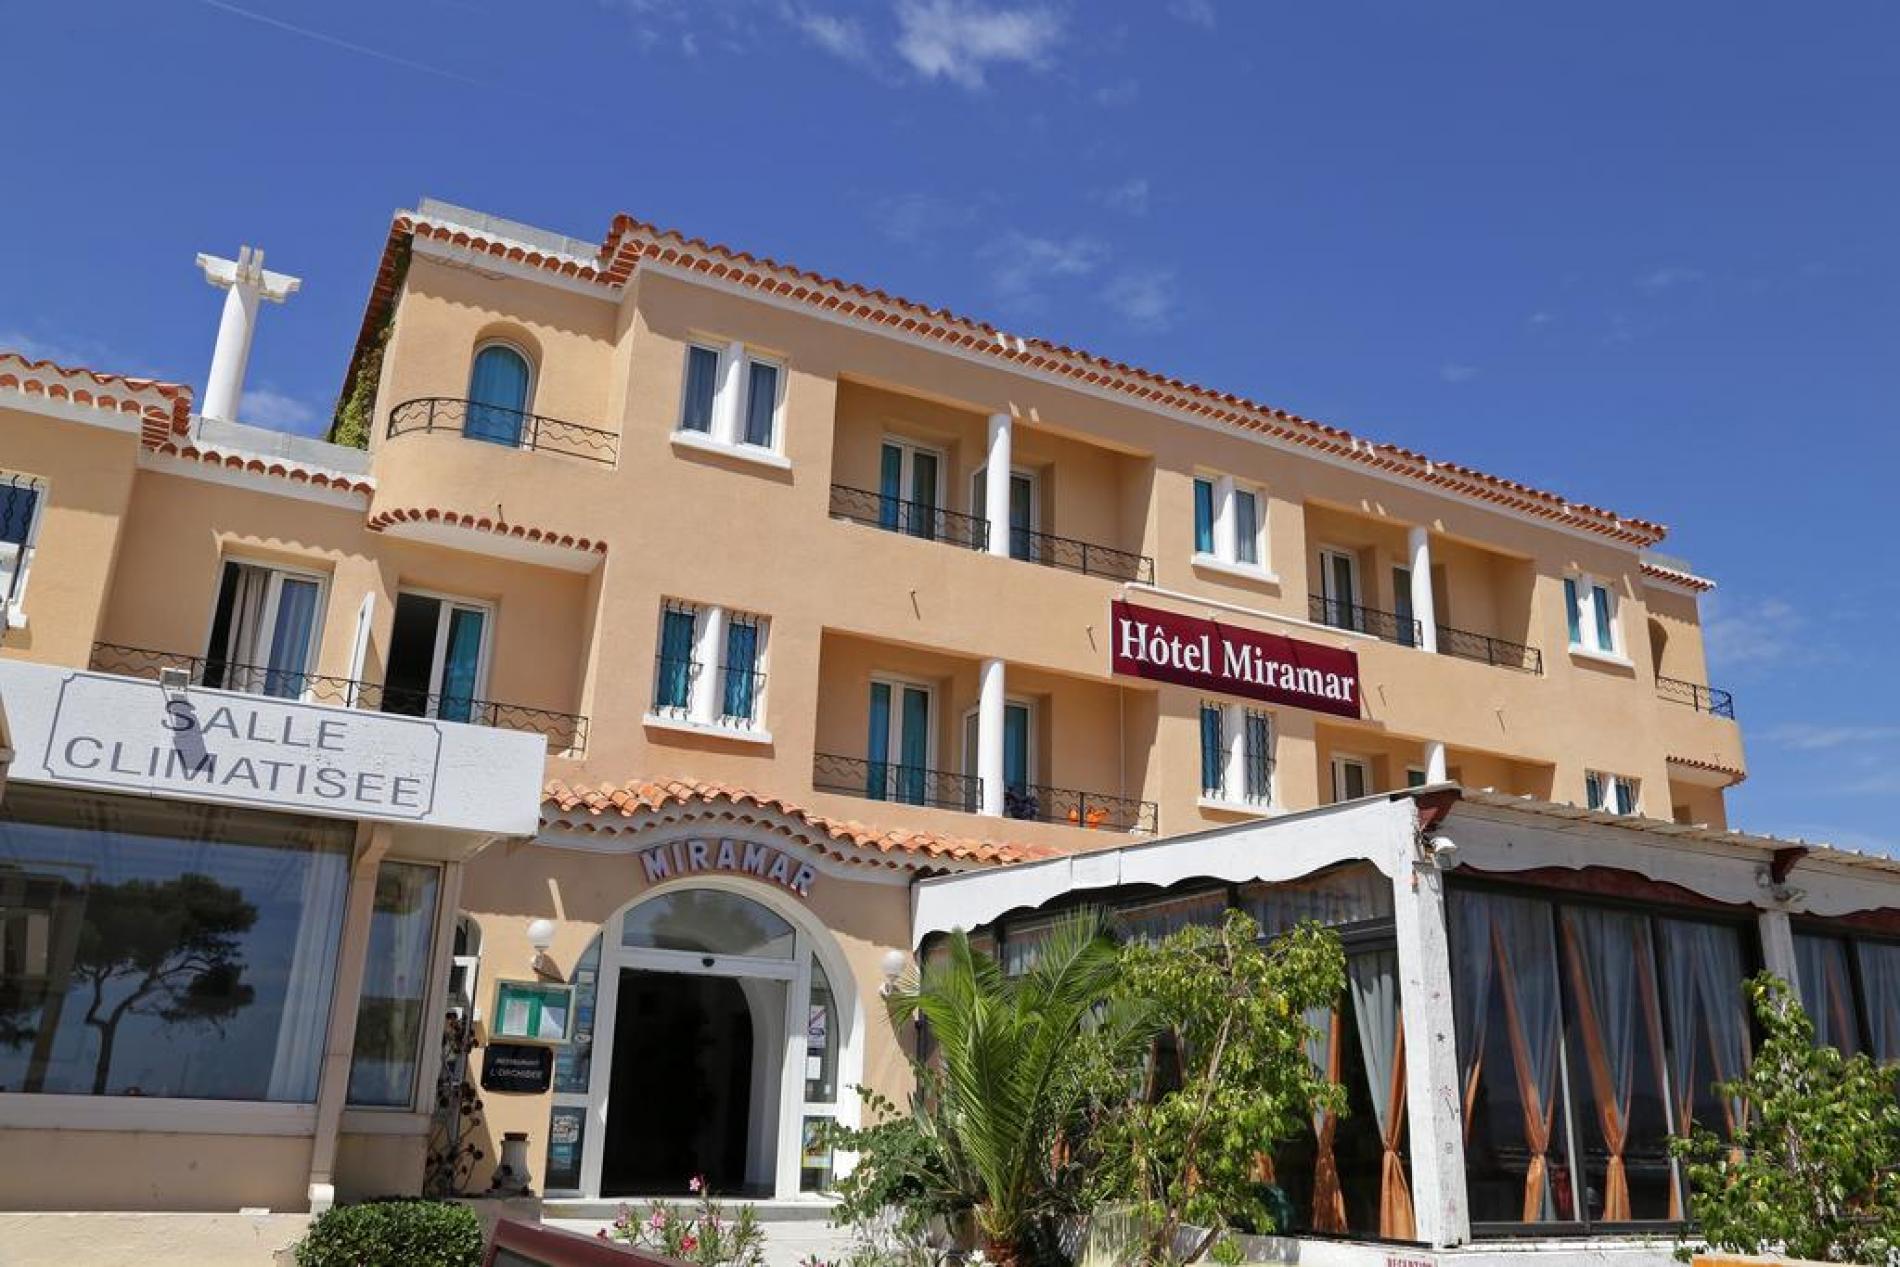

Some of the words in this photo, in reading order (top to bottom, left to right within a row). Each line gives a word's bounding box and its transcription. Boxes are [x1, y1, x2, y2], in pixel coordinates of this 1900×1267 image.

[1119, 618, 1213, 674] Hôtel
[1222, 640, 1355, 702] Miramar
[161, 700, 348, 752] SALLE
[65, 736, 421, 808] CLIMATISEE
[640, 838, 816, 898] MIRAMAR
